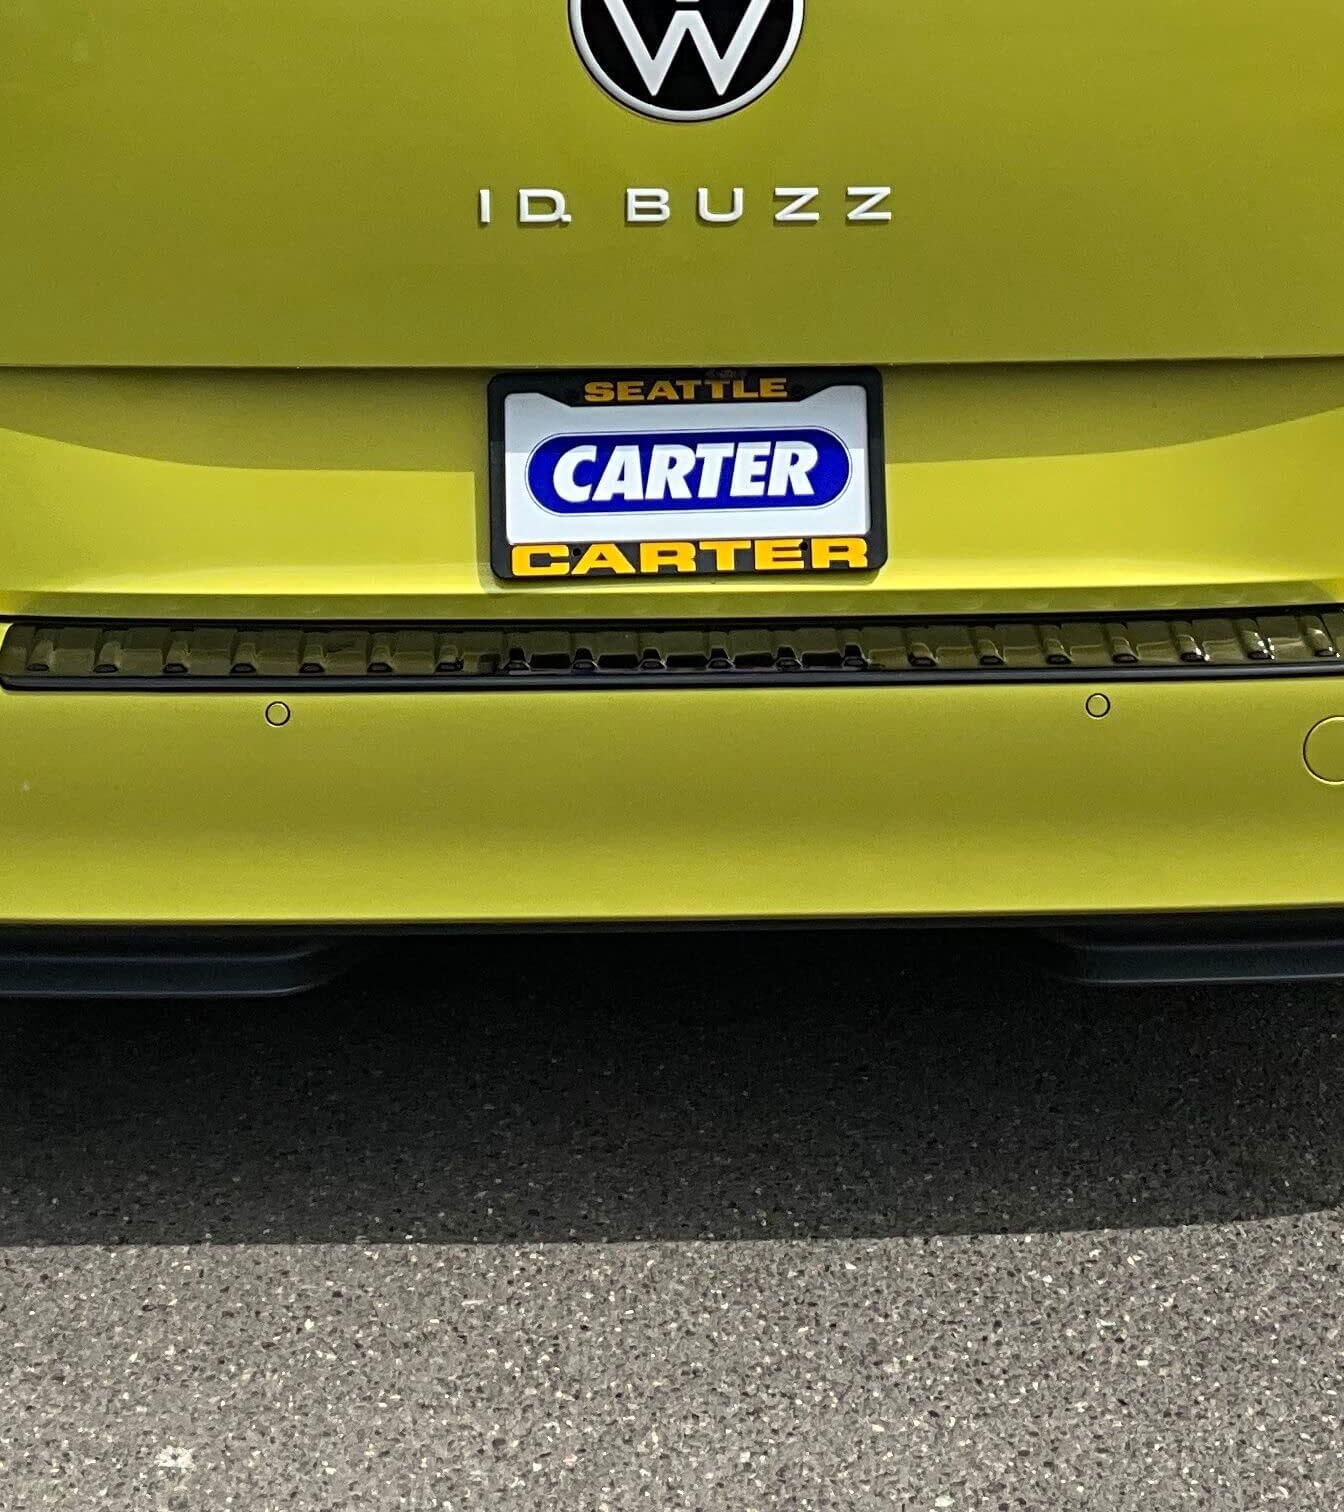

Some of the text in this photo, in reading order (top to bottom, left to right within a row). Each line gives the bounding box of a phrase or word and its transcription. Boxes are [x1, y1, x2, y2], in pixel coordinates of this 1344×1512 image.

[626, 186, 893, 223] BUZZ
[584, 377, 788, 402] SEATTLE
[552, 440, 819, 503] CARTER
[511, 537, 868, 577] CARTER
